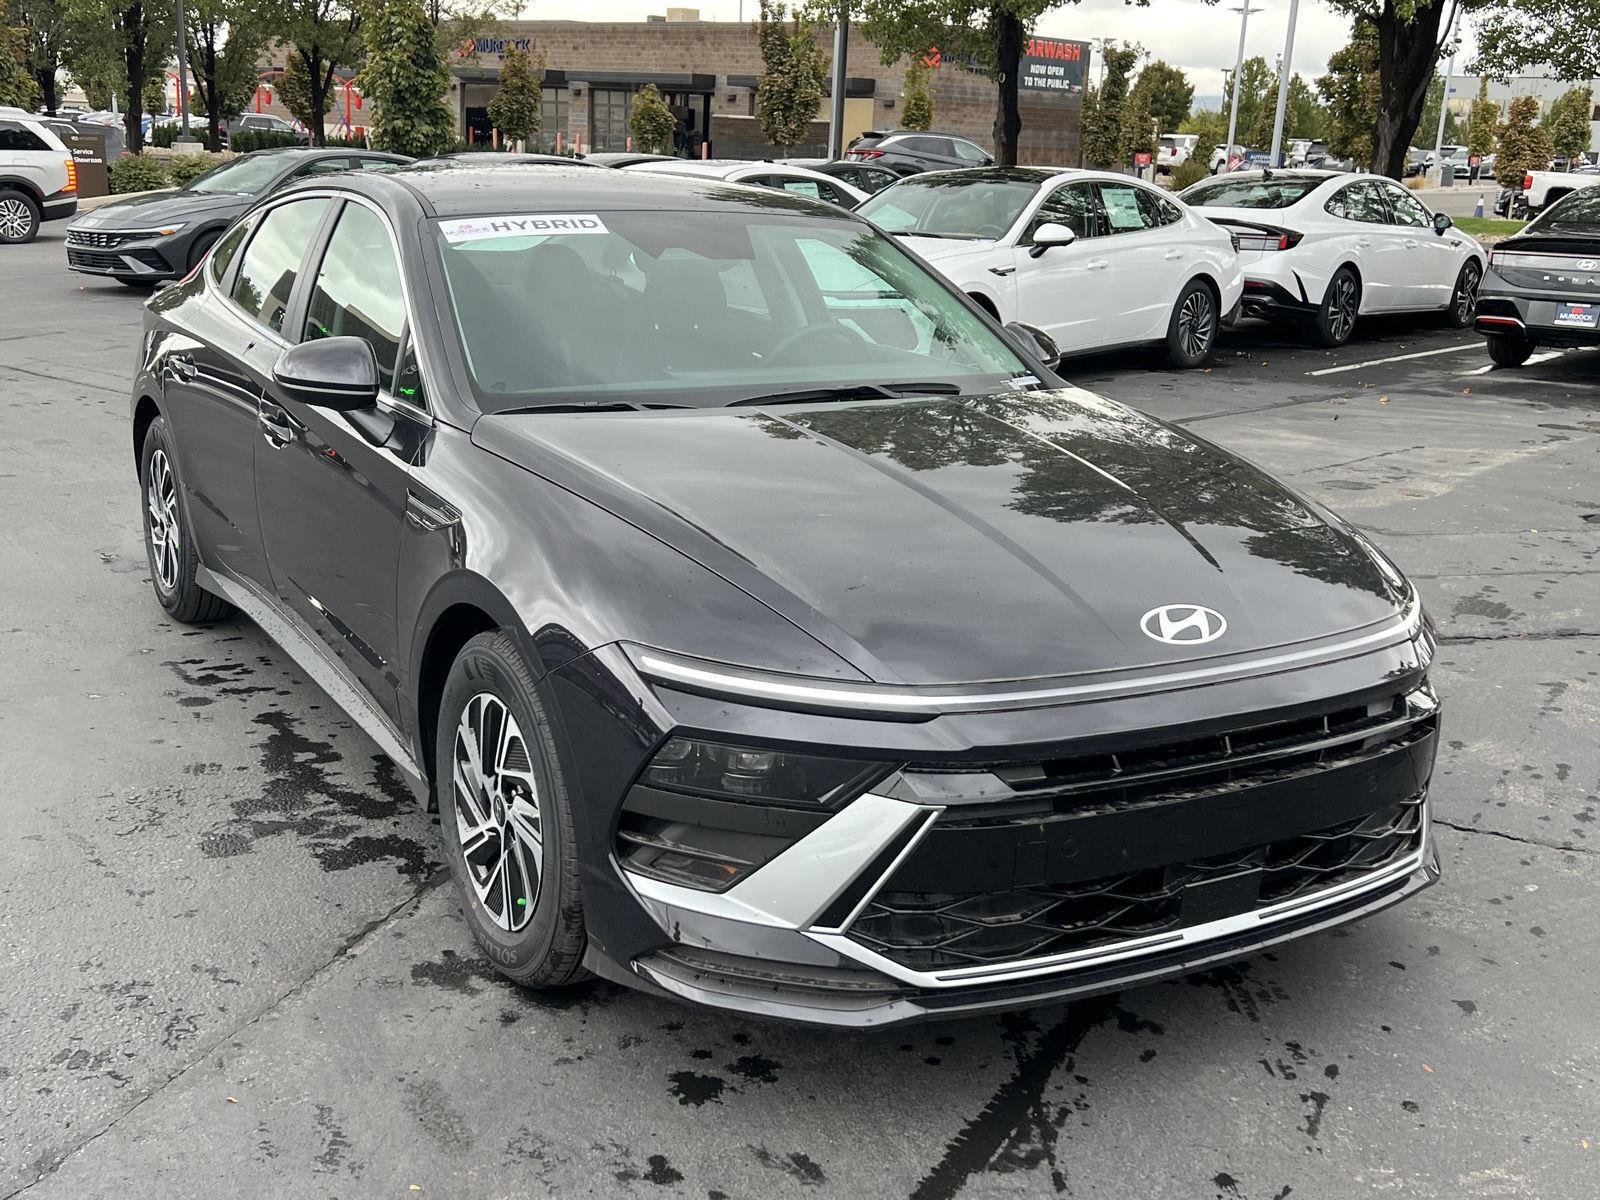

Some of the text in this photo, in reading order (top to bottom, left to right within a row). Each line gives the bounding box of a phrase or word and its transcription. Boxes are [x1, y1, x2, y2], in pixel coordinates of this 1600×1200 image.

[476, 38, 530, 53] MURDCK
[1024, 39, 1081, 61] ARWASH
[1030, 64, 1064, 76] NOW OPEN
[1024, 77, 1070, 89] TO THE PUBLIC
[490, 219, 599, 232] HYBRID
